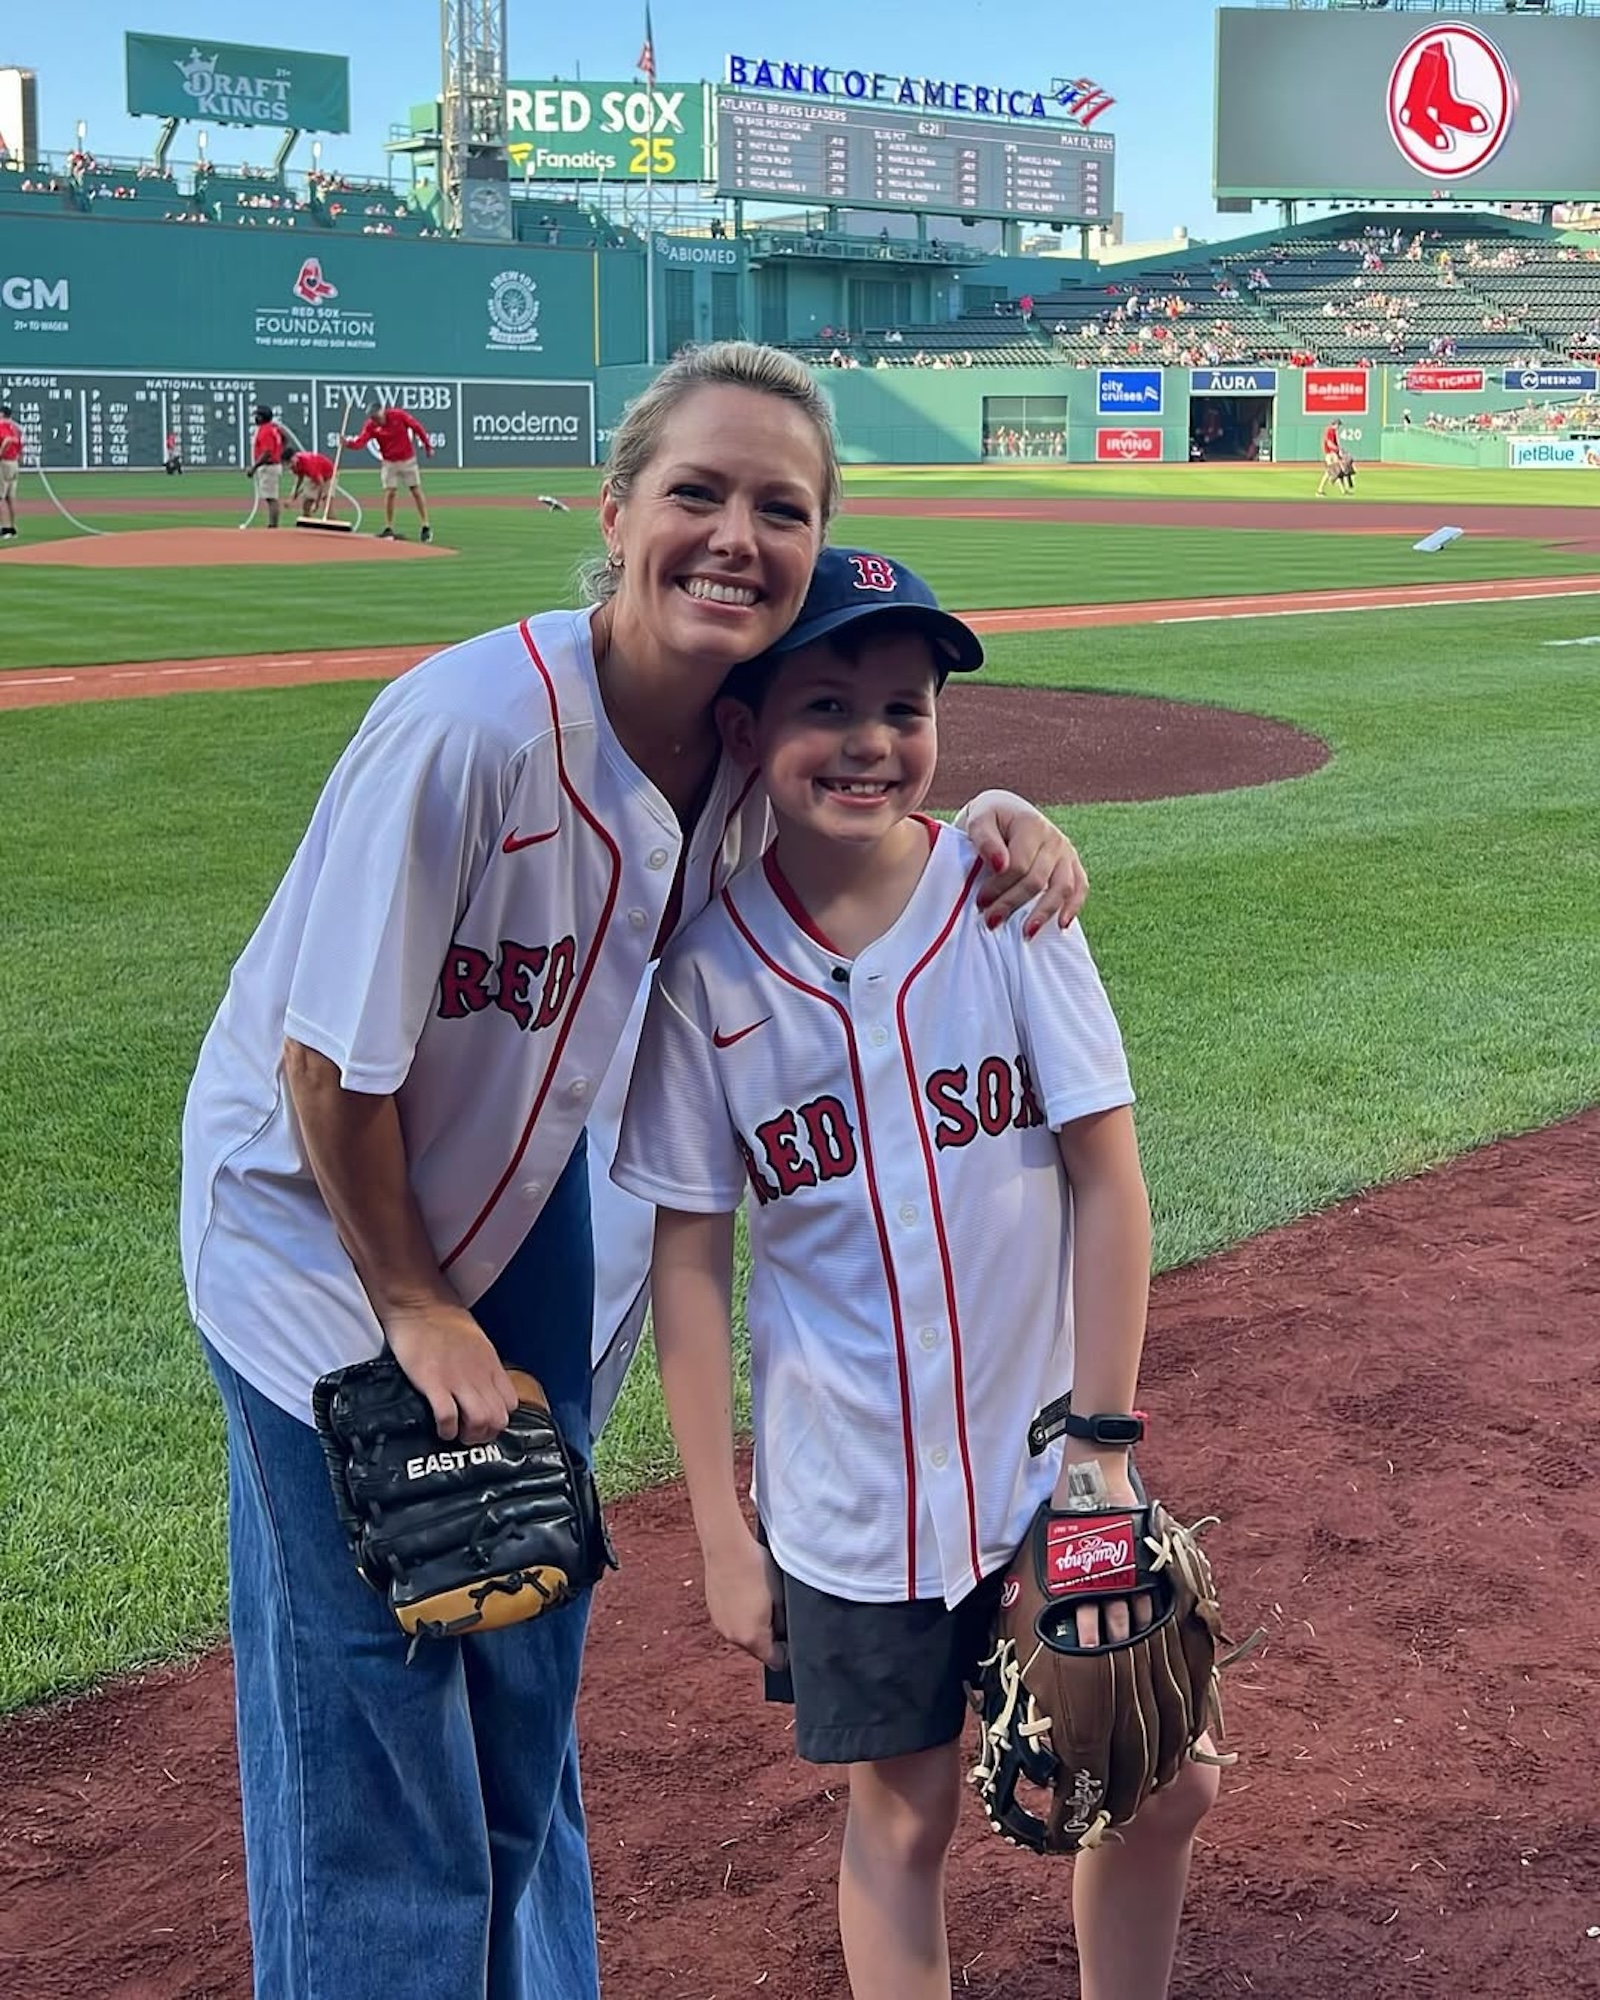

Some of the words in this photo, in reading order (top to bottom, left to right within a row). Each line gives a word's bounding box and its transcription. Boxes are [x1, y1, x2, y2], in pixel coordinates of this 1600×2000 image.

[183, 71, 291, 100] DRAFT
[728, 53, 831, 95] BANK
[843, 69, 888, 102] OF
[897, 75, 1047, 119] AMERICA
[198, 93, 289, 121] KINGS
[506, 89, 591, 132] RED
[600, 91, 686, 134] SOX
[720, 98, 765, 113] ATLANTA
[766, 103, 803, 118] BRAVES
[804, 107, 847, 122] LEADERS
[536, 149, 616, 169] Fanatics
[629, 137, 676, 174] 25
[668, 246, 737, 265] ABIOMED
[0, 276, 69, 311] GM
[291, 306, 315, 317] RED
[317, 307, 340, 318] SOX
[255, 317, 375, 336] FOUNDATION
[7, 376, 58, 388] LEAGUE
[145, 379, 206, 390] NATIONAL
[209, 381, 256, 392] LEAGUE
[1101, 380, 1124, 394] city
[1307, 383, 1364, 396] Safelite
[1437, 373, 1483, 389] TICKET
[375, 386, 452, 410] WEBB
[1101, 388, 1143, 403] cruises
[20, 402, 40, 413] LAA
[109, 403, 129, 413] ATH
[473, 411, 580, 435] moderna
[1106, 437, 1153, 451] IRVING
[1339, 428, 1363, 441] 420
[1518, 445, 1575, 466] jetBlue
[847, 554, 898, 593] B
[436, 934, 577, 1033] RED
[406, 1444, 502, 1480] EASTON
[1055, 1539, 1129, 1574] Rawlings
